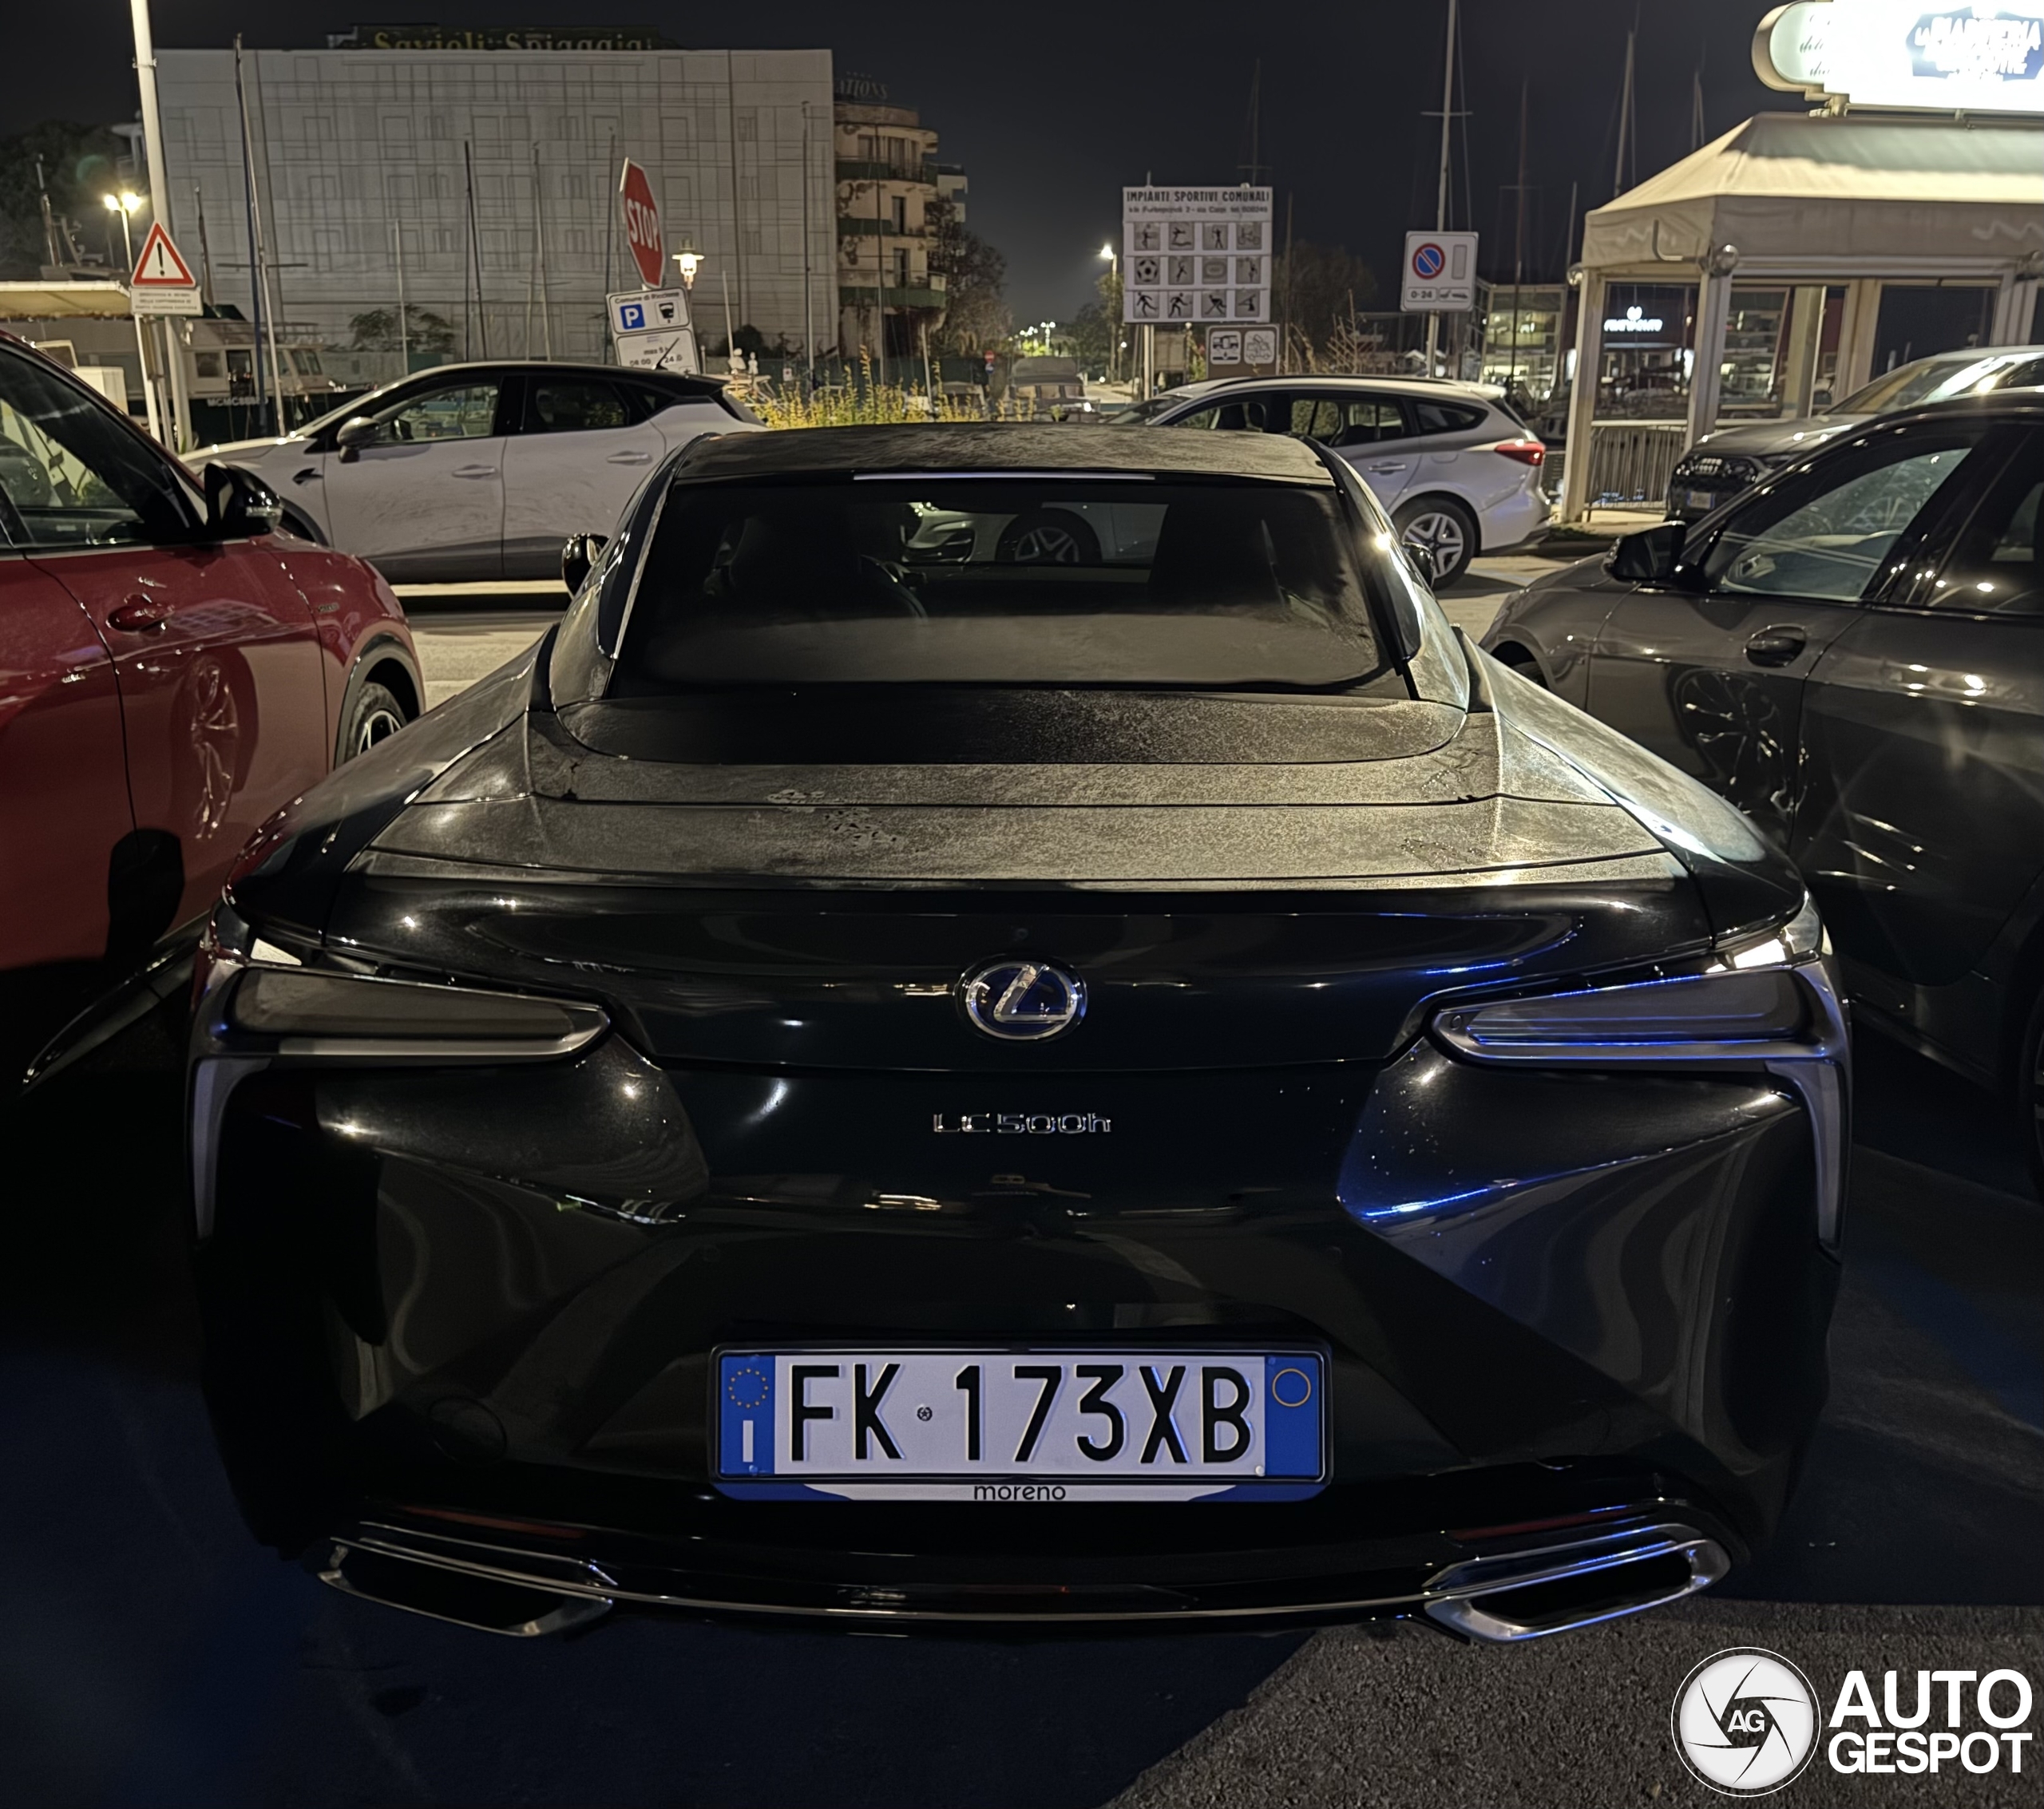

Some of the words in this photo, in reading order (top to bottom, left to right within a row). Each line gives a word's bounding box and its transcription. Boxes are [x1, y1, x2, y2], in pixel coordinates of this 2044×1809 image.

[1127, 191, 1170, 202] IMPIANTI
[1175, 191, 1218, 202] SPORTIVI
[1222, 191, 1270, 202] COMUNALI
[627, 198, 659, 252] STOP
[624, 306, 640, 327] P
[972, 1484, 1067, 1502] moreno
